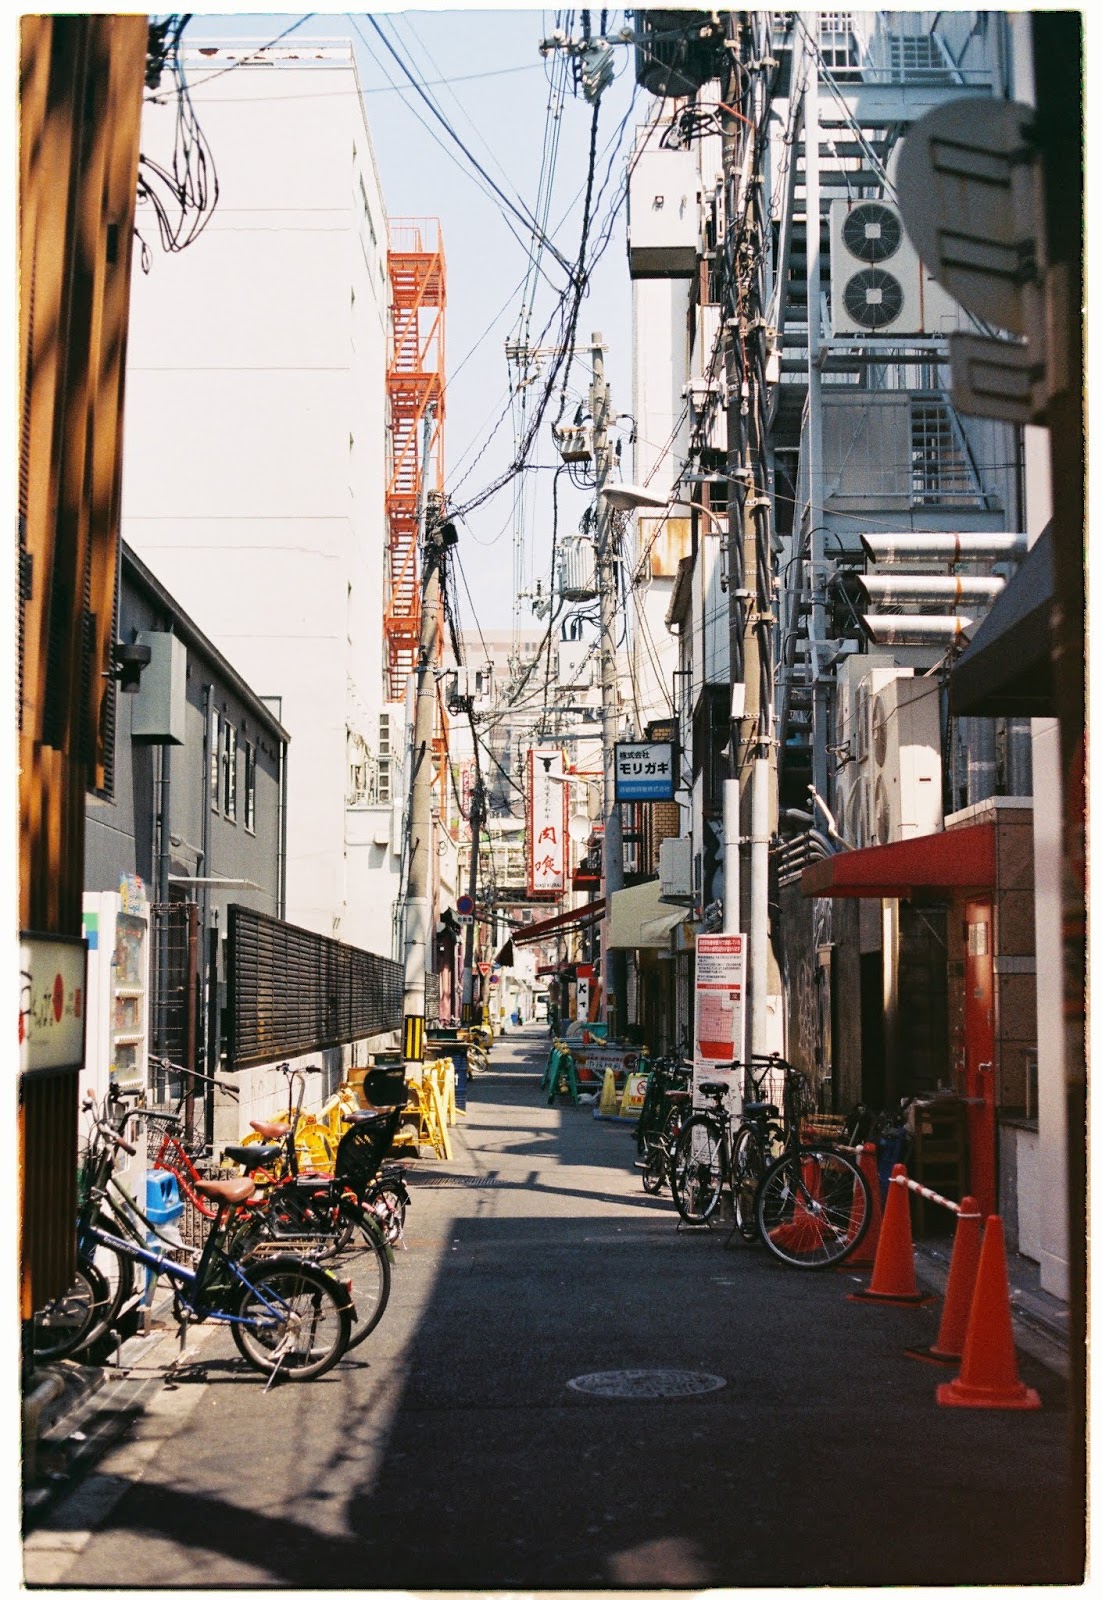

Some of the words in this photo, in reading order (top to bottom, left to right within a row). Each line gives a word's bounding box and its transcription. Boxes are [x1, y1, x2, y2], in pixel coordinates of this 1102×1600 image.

[619, 751, 650, 759] 株式会社
[619, 762, 669, 775] モリガキ
